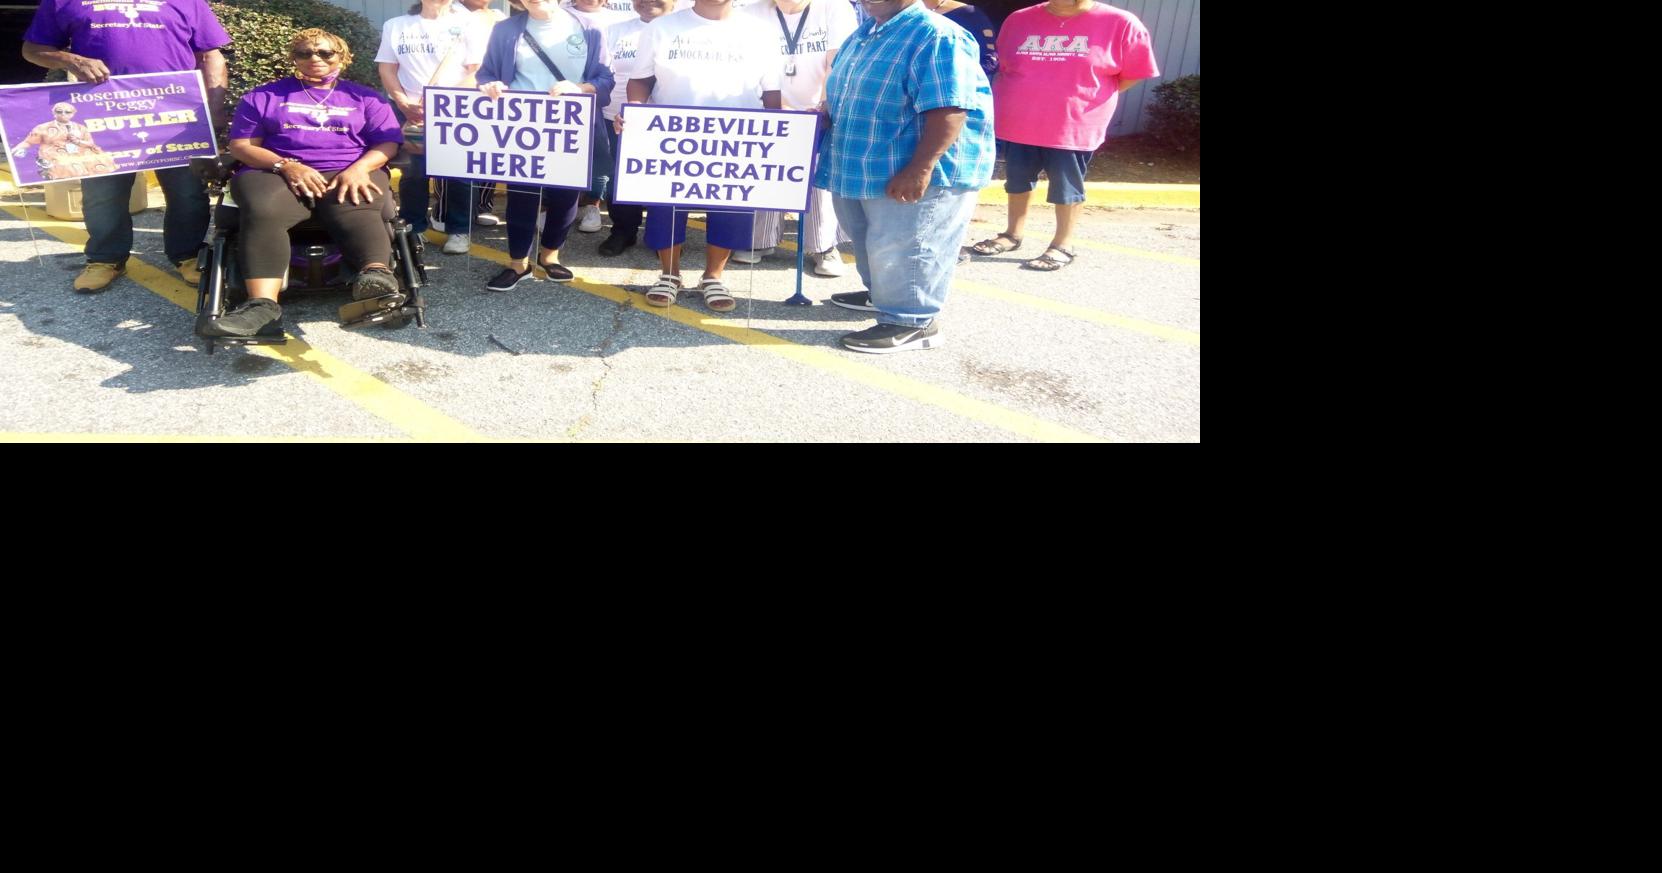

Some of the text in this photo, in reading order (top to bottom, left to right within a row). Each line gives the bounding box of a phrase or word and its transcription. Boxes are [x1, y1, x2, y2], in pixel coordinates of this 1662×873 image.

[1017, 34, 1089, 52] AKA
[71, 83, 186, 104] Rosemounda
[84, 109, 198, 133] BUTLER
[433, 94, 584, 126] REGISTER
[435, 122, 580, 154] TO VOTE
[646, 114, 790, 138] ABBEVILLE
[145, 141, 210, 155] of State
[659, 137, 774, 160] COUNTY
[466, 151, 546, 180] HERE
[625, 157, 805, 183] DEMOCRATIC
[670, 181, 755, 202] PARTY
